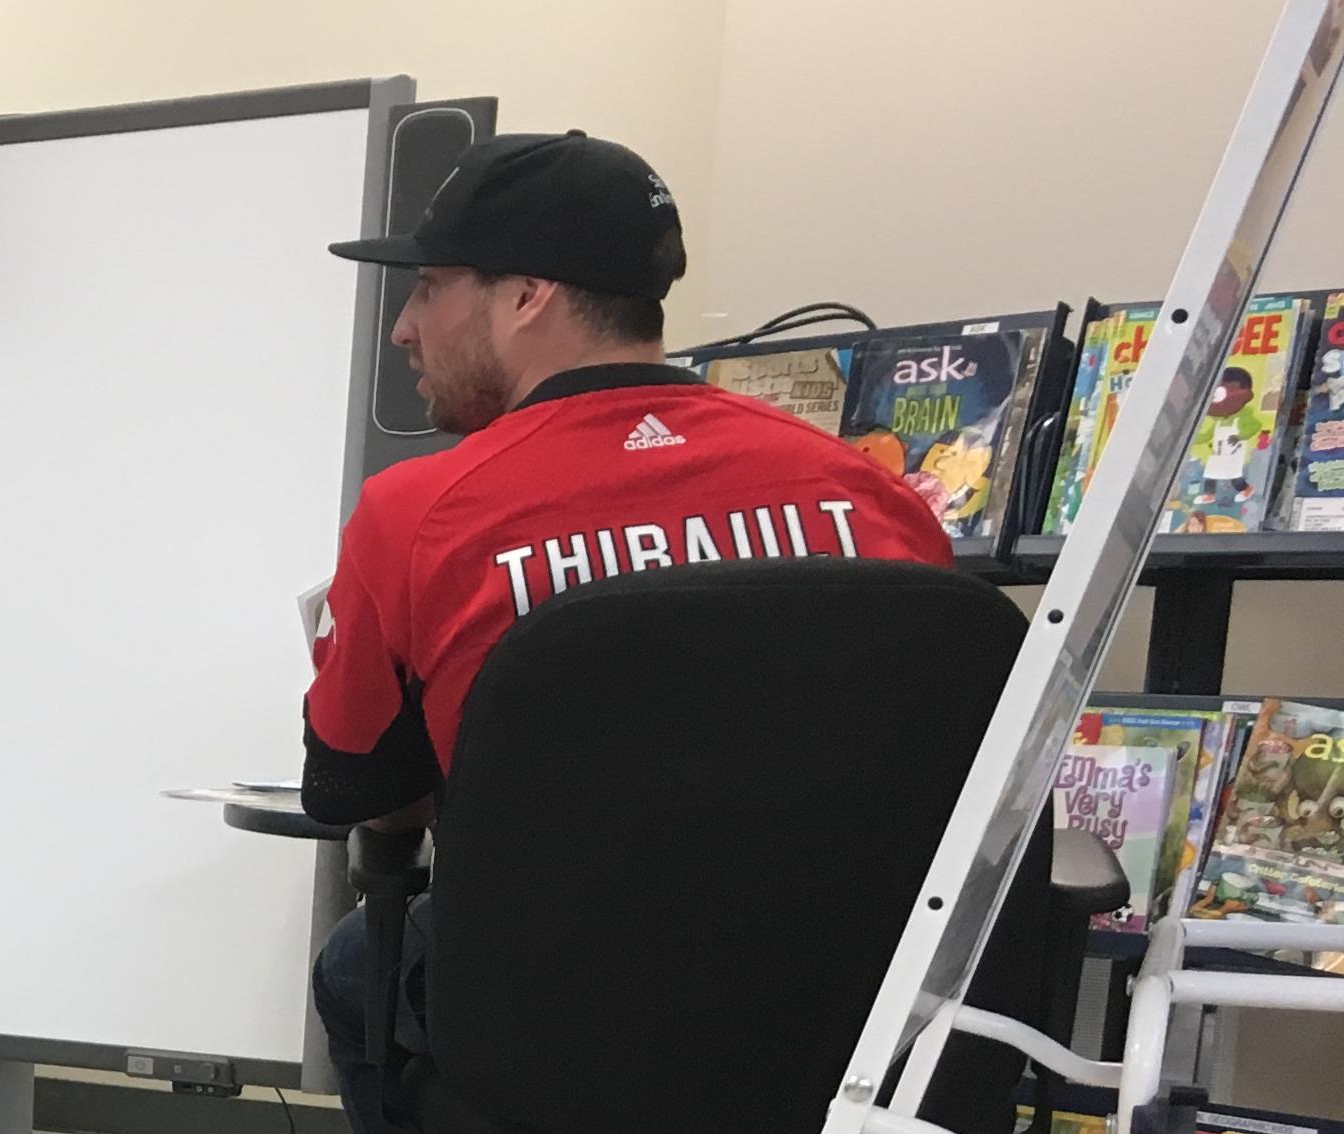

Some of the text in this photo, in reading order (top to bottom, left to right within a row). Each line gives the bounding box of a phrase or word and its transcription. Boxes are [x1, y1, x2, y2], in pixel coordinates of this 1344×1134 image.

[893, 345, 965, 384] ask
[892, 395, 961, 436] BRAIN
[624, 434, 687, 451] adidas
[494, 498, 861, 618] THIBAULT
[1054, 754, 1153, 793] Emma's
[1065, 784, 1128, 819] Very
